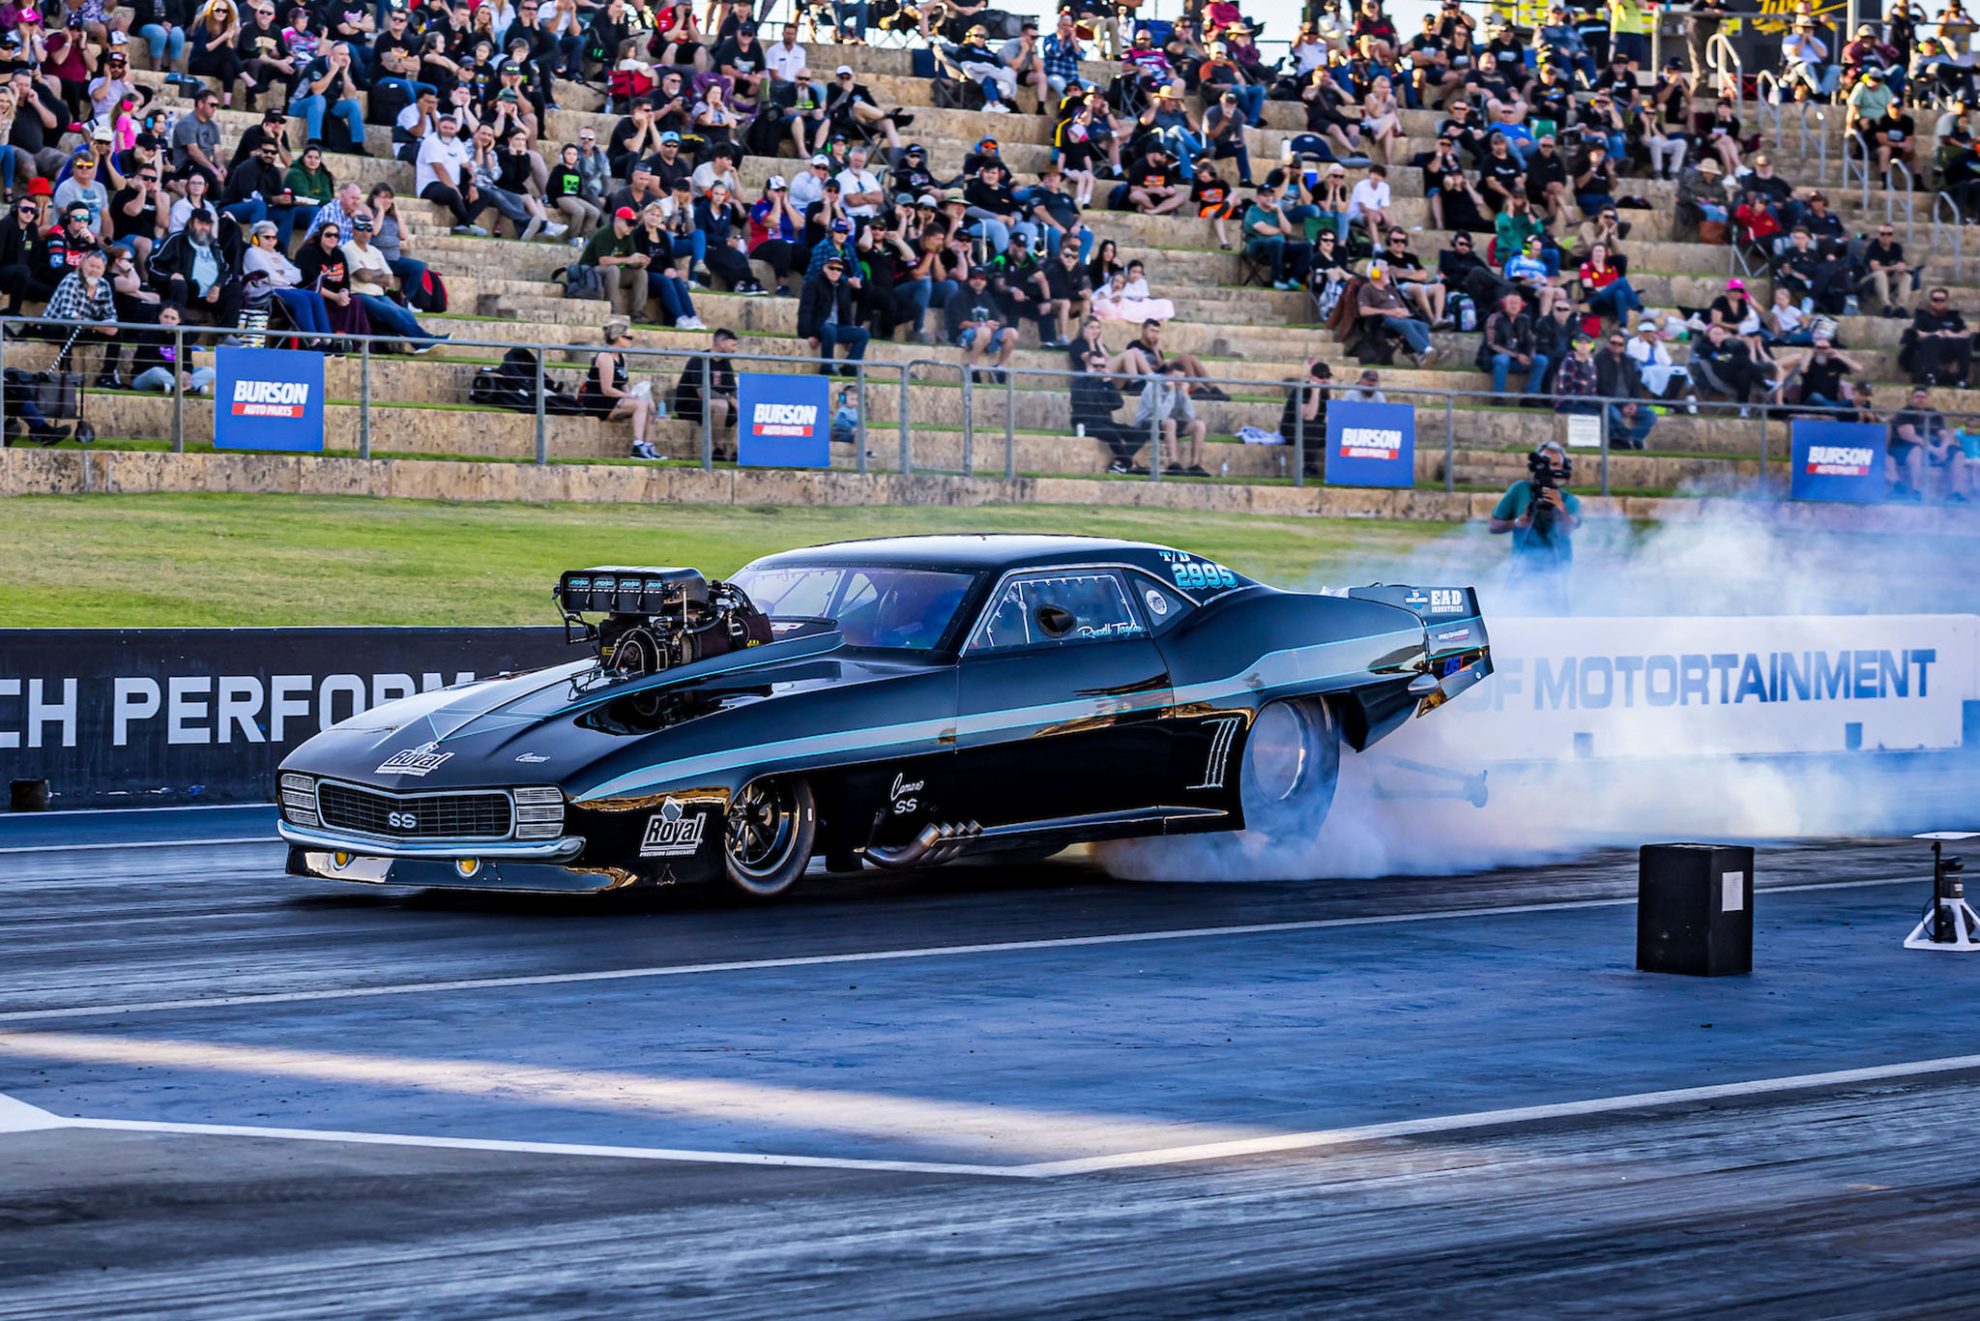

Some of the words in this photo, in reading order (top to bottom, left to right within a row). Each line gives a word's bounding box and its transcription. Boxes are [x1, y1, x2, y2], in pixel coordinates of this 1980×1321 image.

[233, 380, 309, 404] BURSON
[753, 403, 818, 425] BURSON
[1342, 427, 1402, 449] BURSON
[1808, 446, 1873, 466] BURSON
[1171, 562, 1238, 588] 2995
[1431, 590, 1463, 605] EAD
[1534, 648, 1937, 710] MOTORTAINMENT
[113, 673, 476, 746] PERFO
[893, 798, 918, 814] SS
[388, 811, 418, 828] SS
[643, 812, 706, 847] Royal
